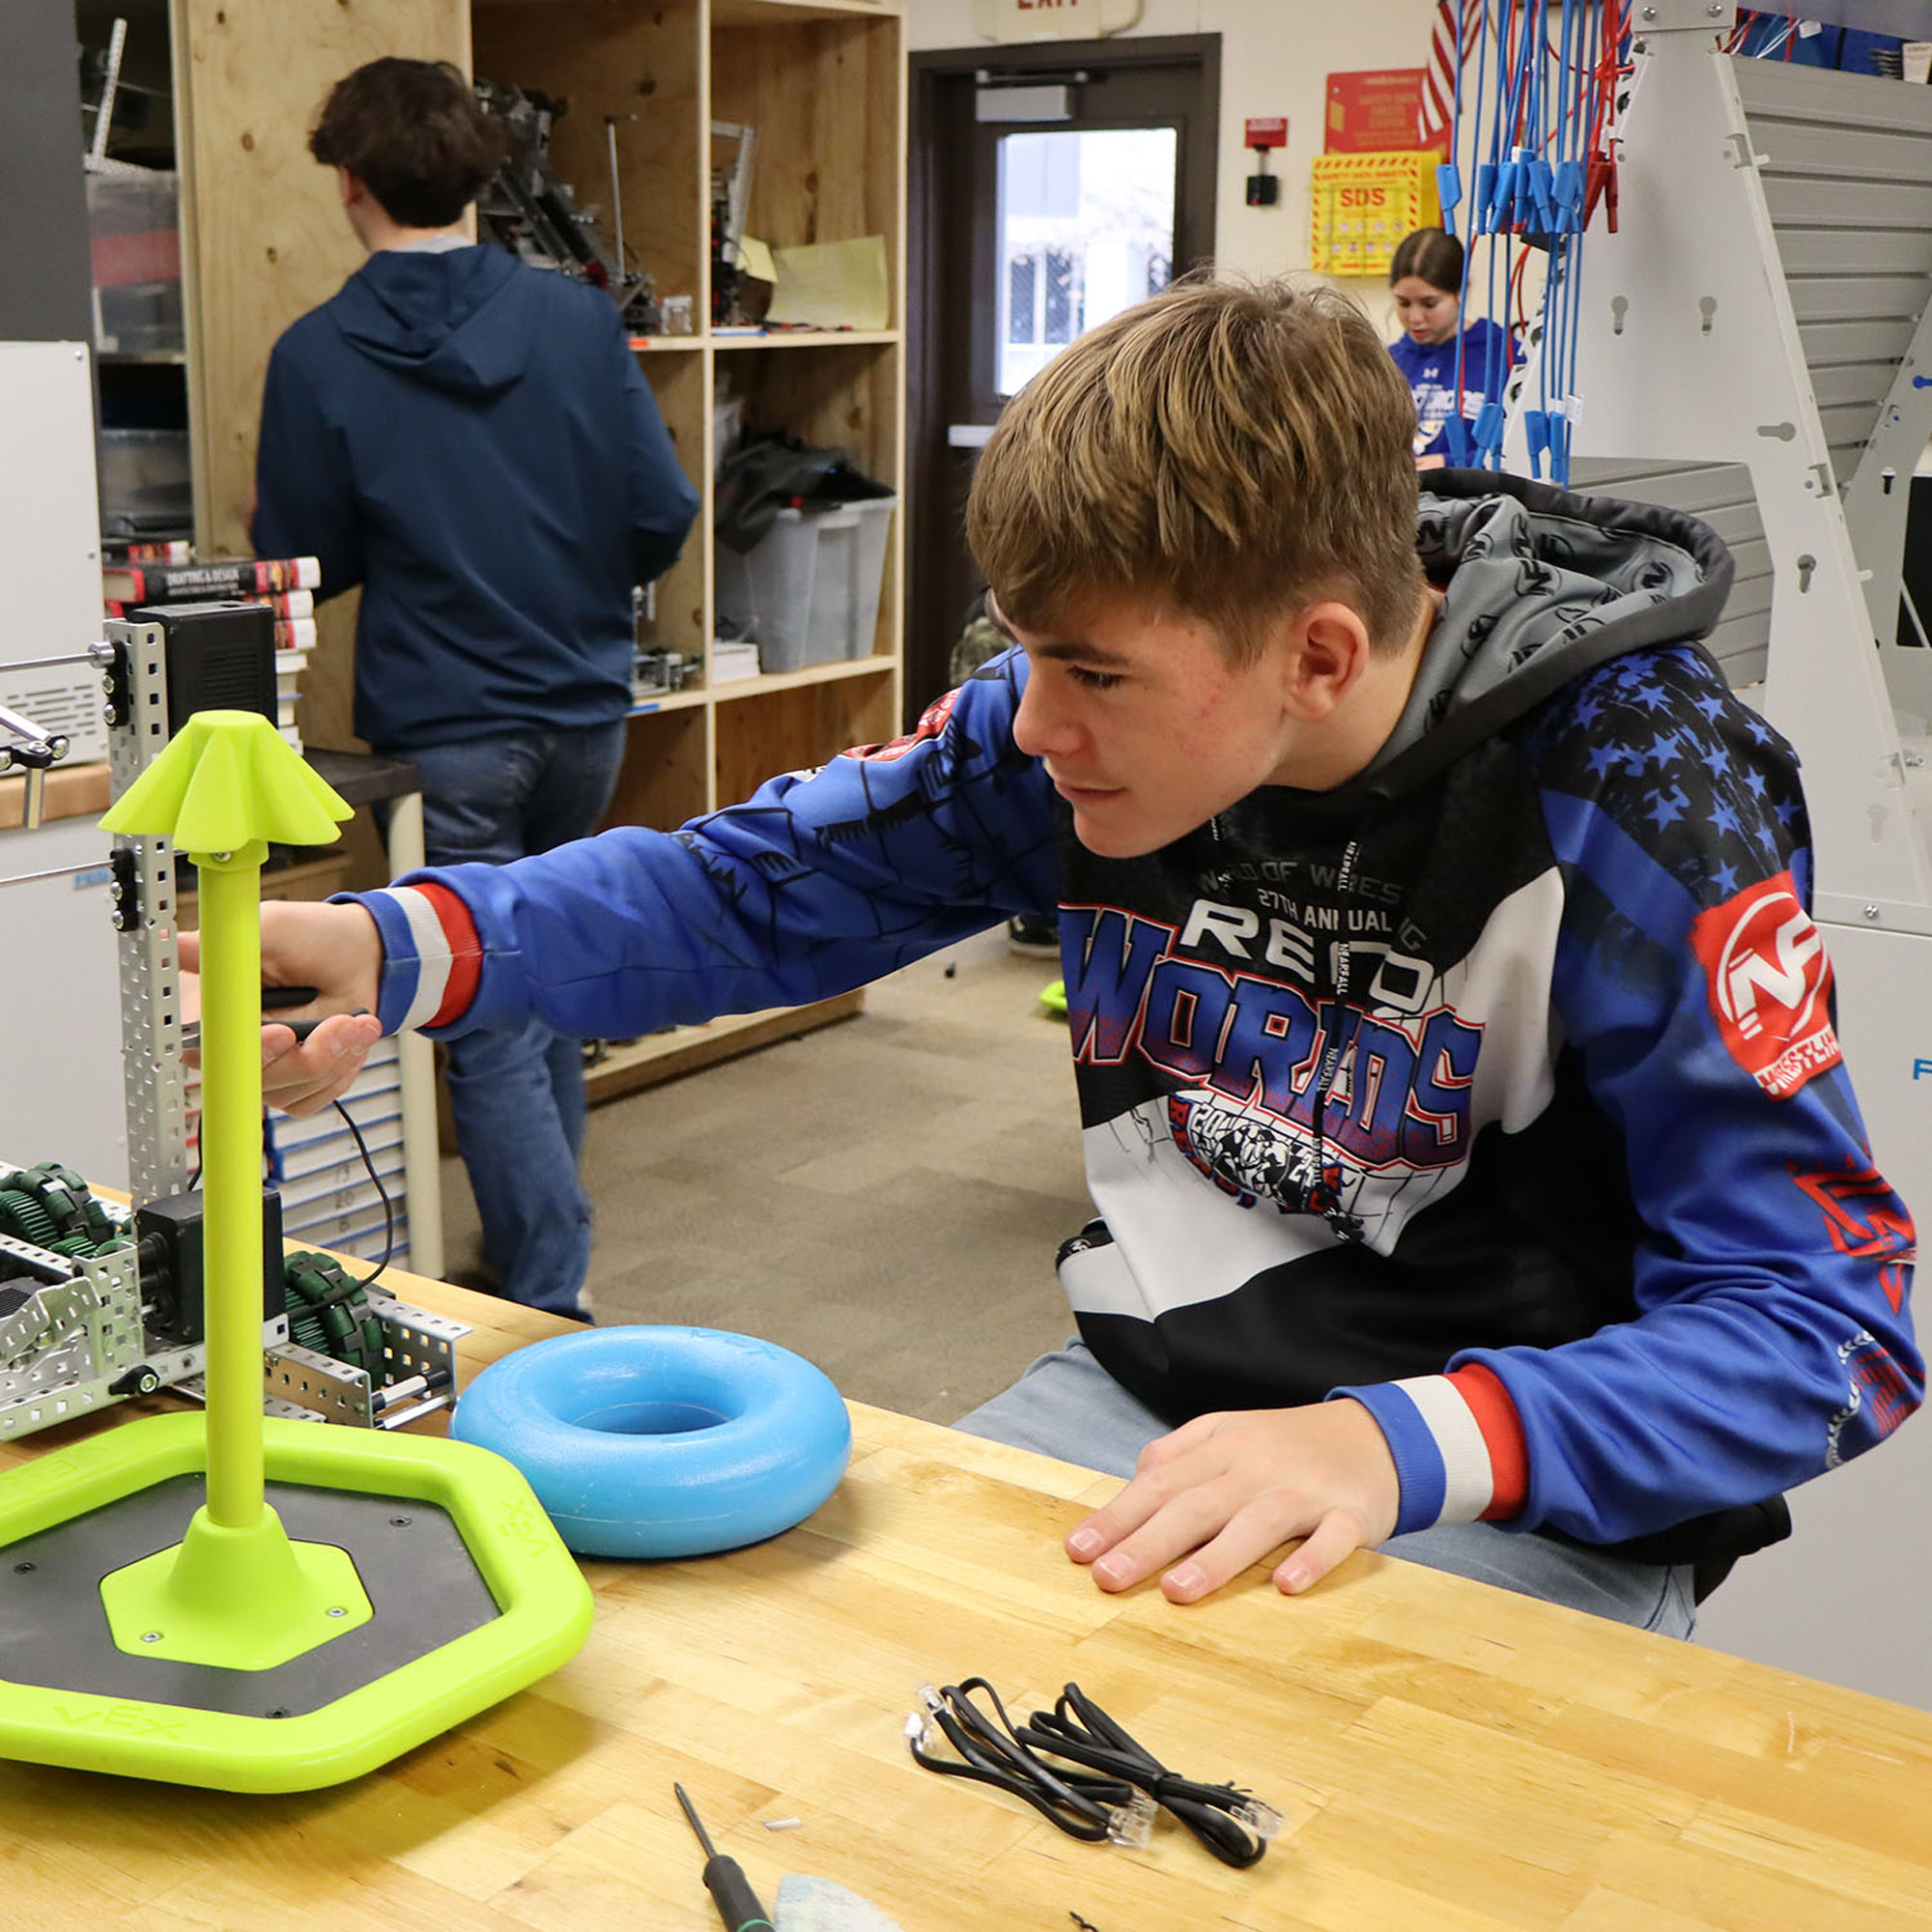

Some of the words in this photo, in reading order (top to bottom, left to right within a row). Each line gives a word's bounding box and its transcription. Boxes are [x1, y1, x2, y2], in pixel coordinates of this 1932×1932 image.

[1340, 187, 1385, 207] SDS
[1257, 888, 1299, 921] 27TH
[1336, 943, 1350, 996] NEARFALL
[1316, 1047, 1340, 1093] NEARFALL
[497, 1497, 551, 1558] VEX
[54, 1705, 186, 1741] VEX
